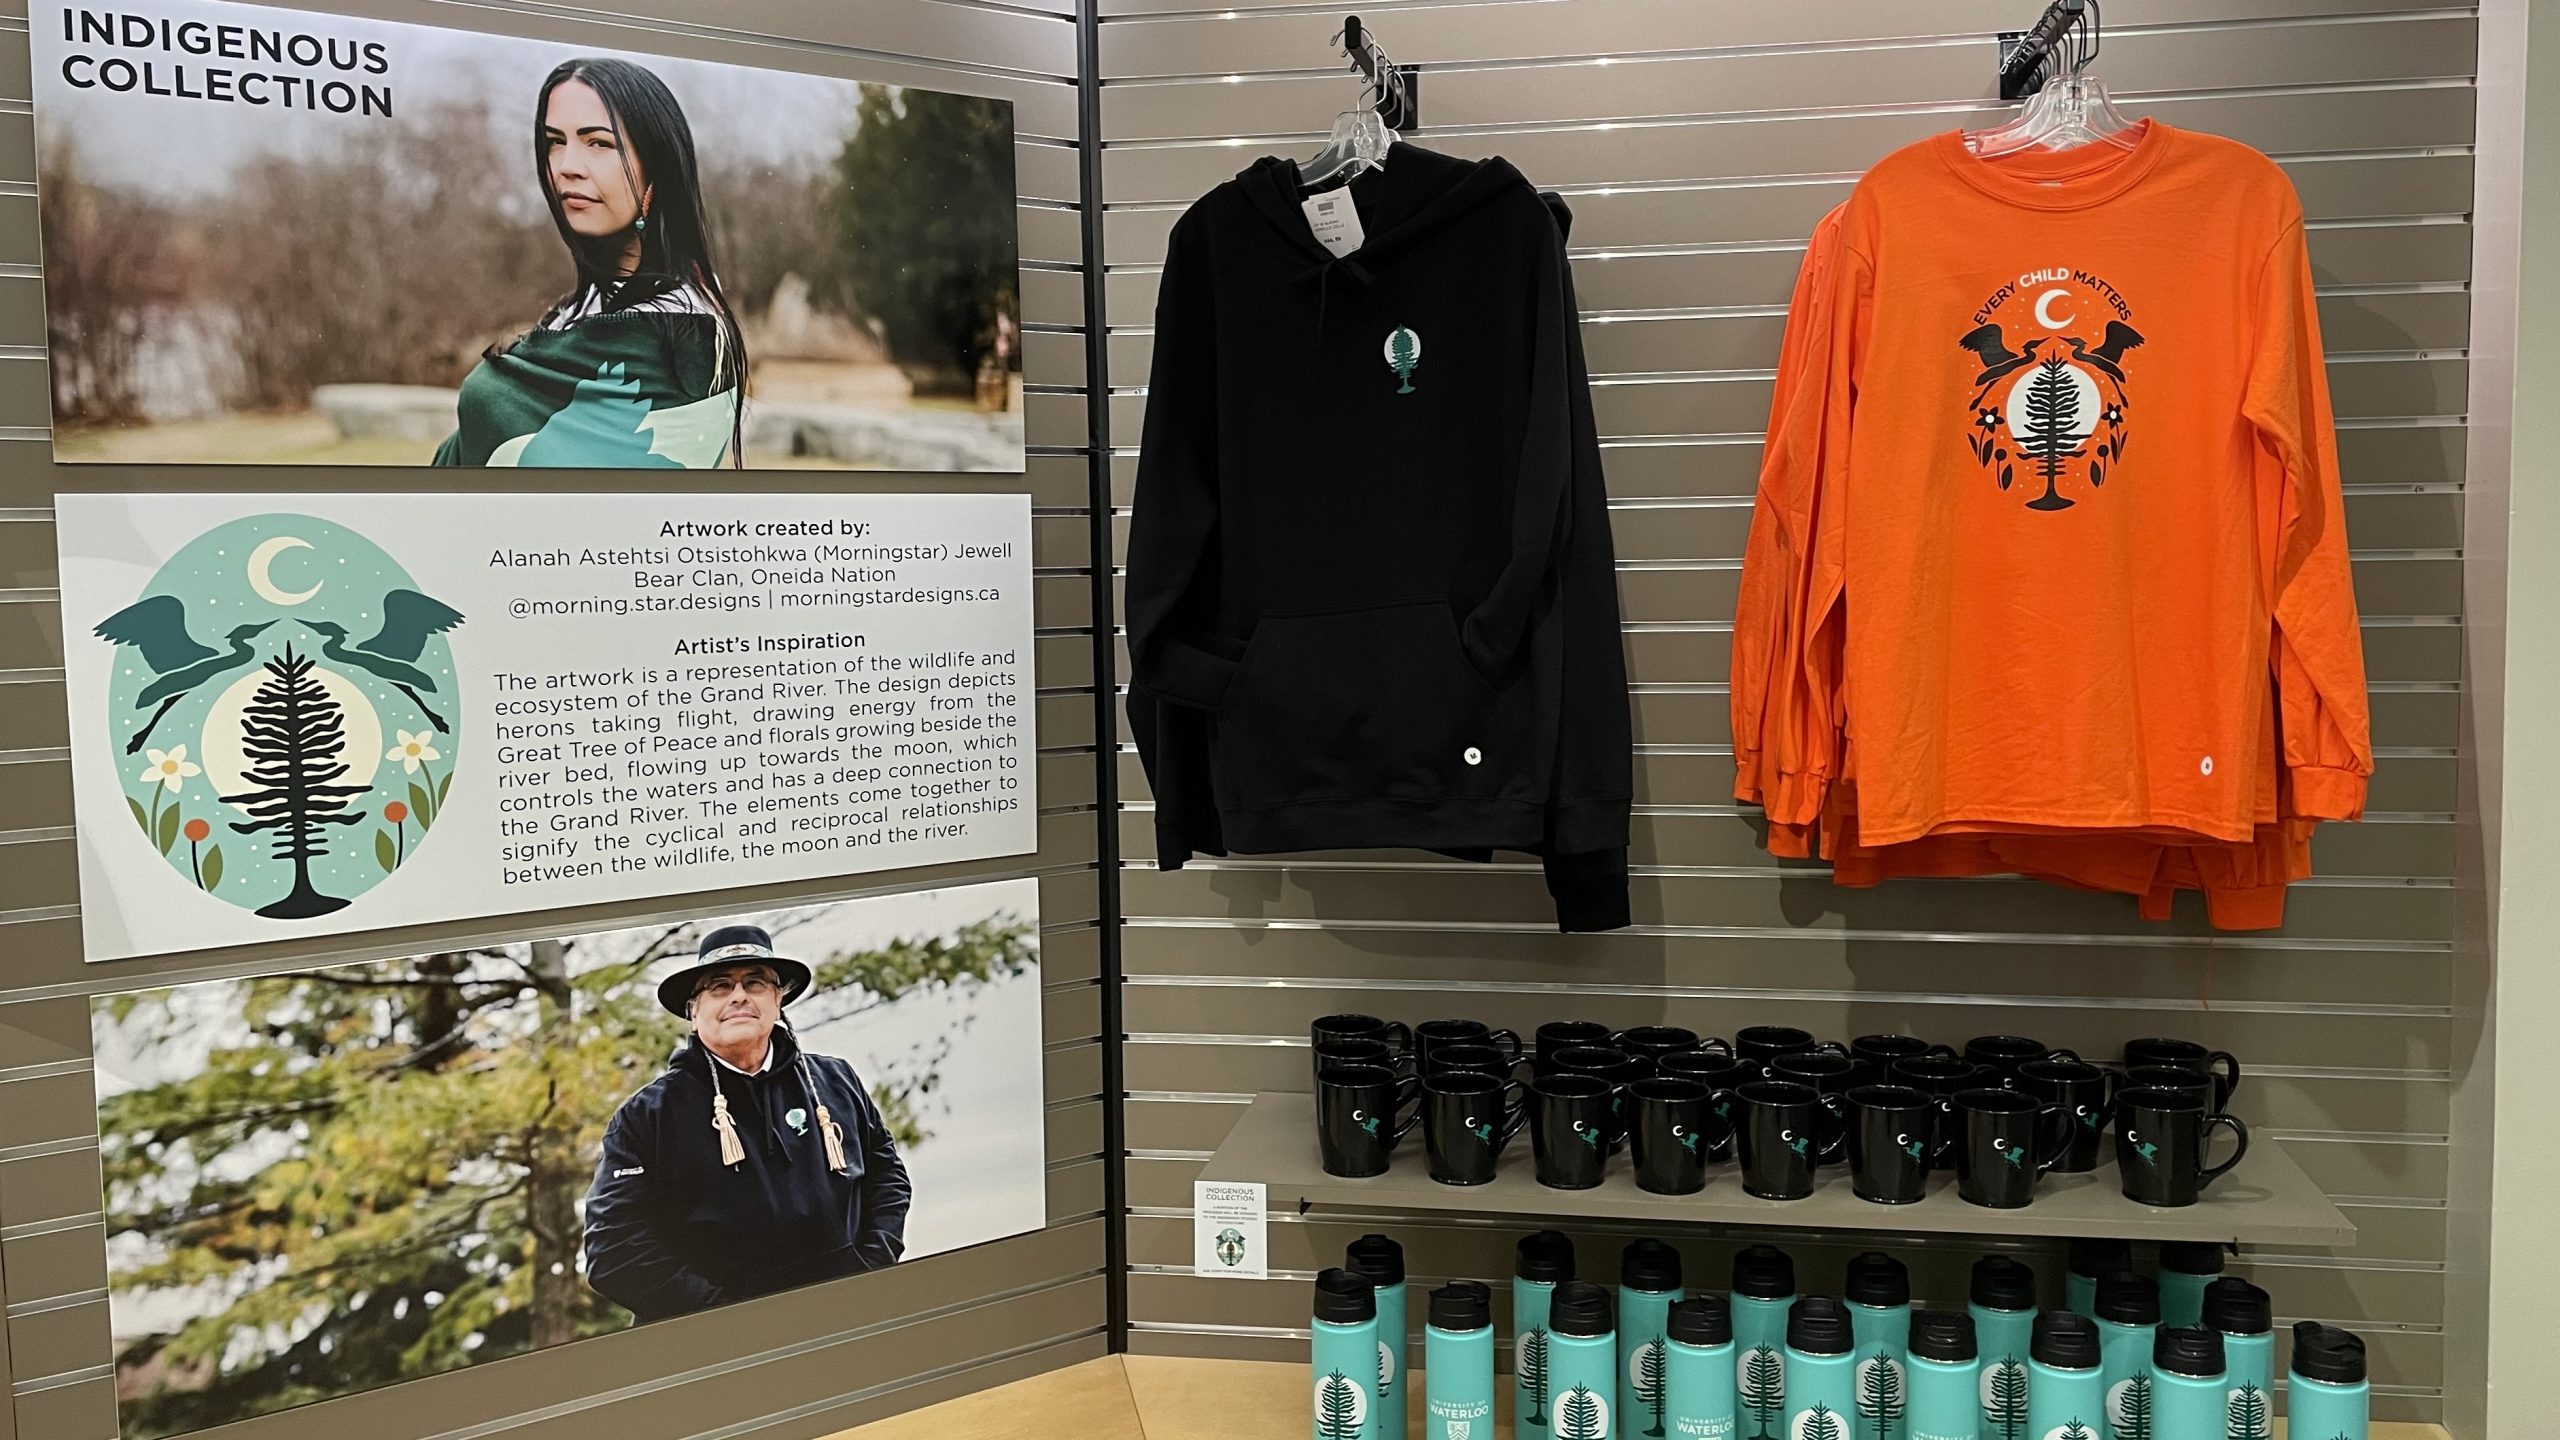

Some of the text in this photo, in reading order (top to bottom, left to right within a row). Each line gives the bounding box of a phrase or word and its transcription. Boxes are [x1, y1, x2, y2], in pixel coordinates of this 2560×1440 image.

[63, 8, 389, 75] INDIGENOUS
[62, 55, 393, 118] COLLECTION
[1973, 267, 2132, 325] EVERY CHILD MATTERS
[660, 519, 869, 538] Artwork created by:
[490, 542, 1011, 567] Alanah Astehtsi Otsistohkwa (Morningstar) Jewell
[635, 566, 895, 588] Bear Clan, Oneida Nation
[509, 591, 760, 619] @morning.star.designs
[782, 587, 999, 607] morningstardesigns.ca
[674, 632, 865, 655] Artist’s Inspiration
[493, 649, 1015, 691] The artwork is a representation of the wildlife and
[496, 671, 1015, 717] ecosystem of the Grand River. The design depicts
[497, 692, 1016, 740] herons taking flight, drawing energy from the
[498, 712, 1017, 764] Great Tree of Peace and florals growing beside the
[499, 732, 1016, 788] river bed, flowing up towards the moon, which
[500, 755, 1017, 812] controls the waters and has a deep connection to
[501, 776, 1017, 836] the Grand River. The elements come together to
[502, 795, 1017, 862] signify the cyclical and reciprocal relationships
[504, 823, 968, 885] between the wildlife, the moon and the river.
[1206, 1194, 1254, 1202] COLLECTION
[1430, 1403, 1489, 1419] WATERLOO
